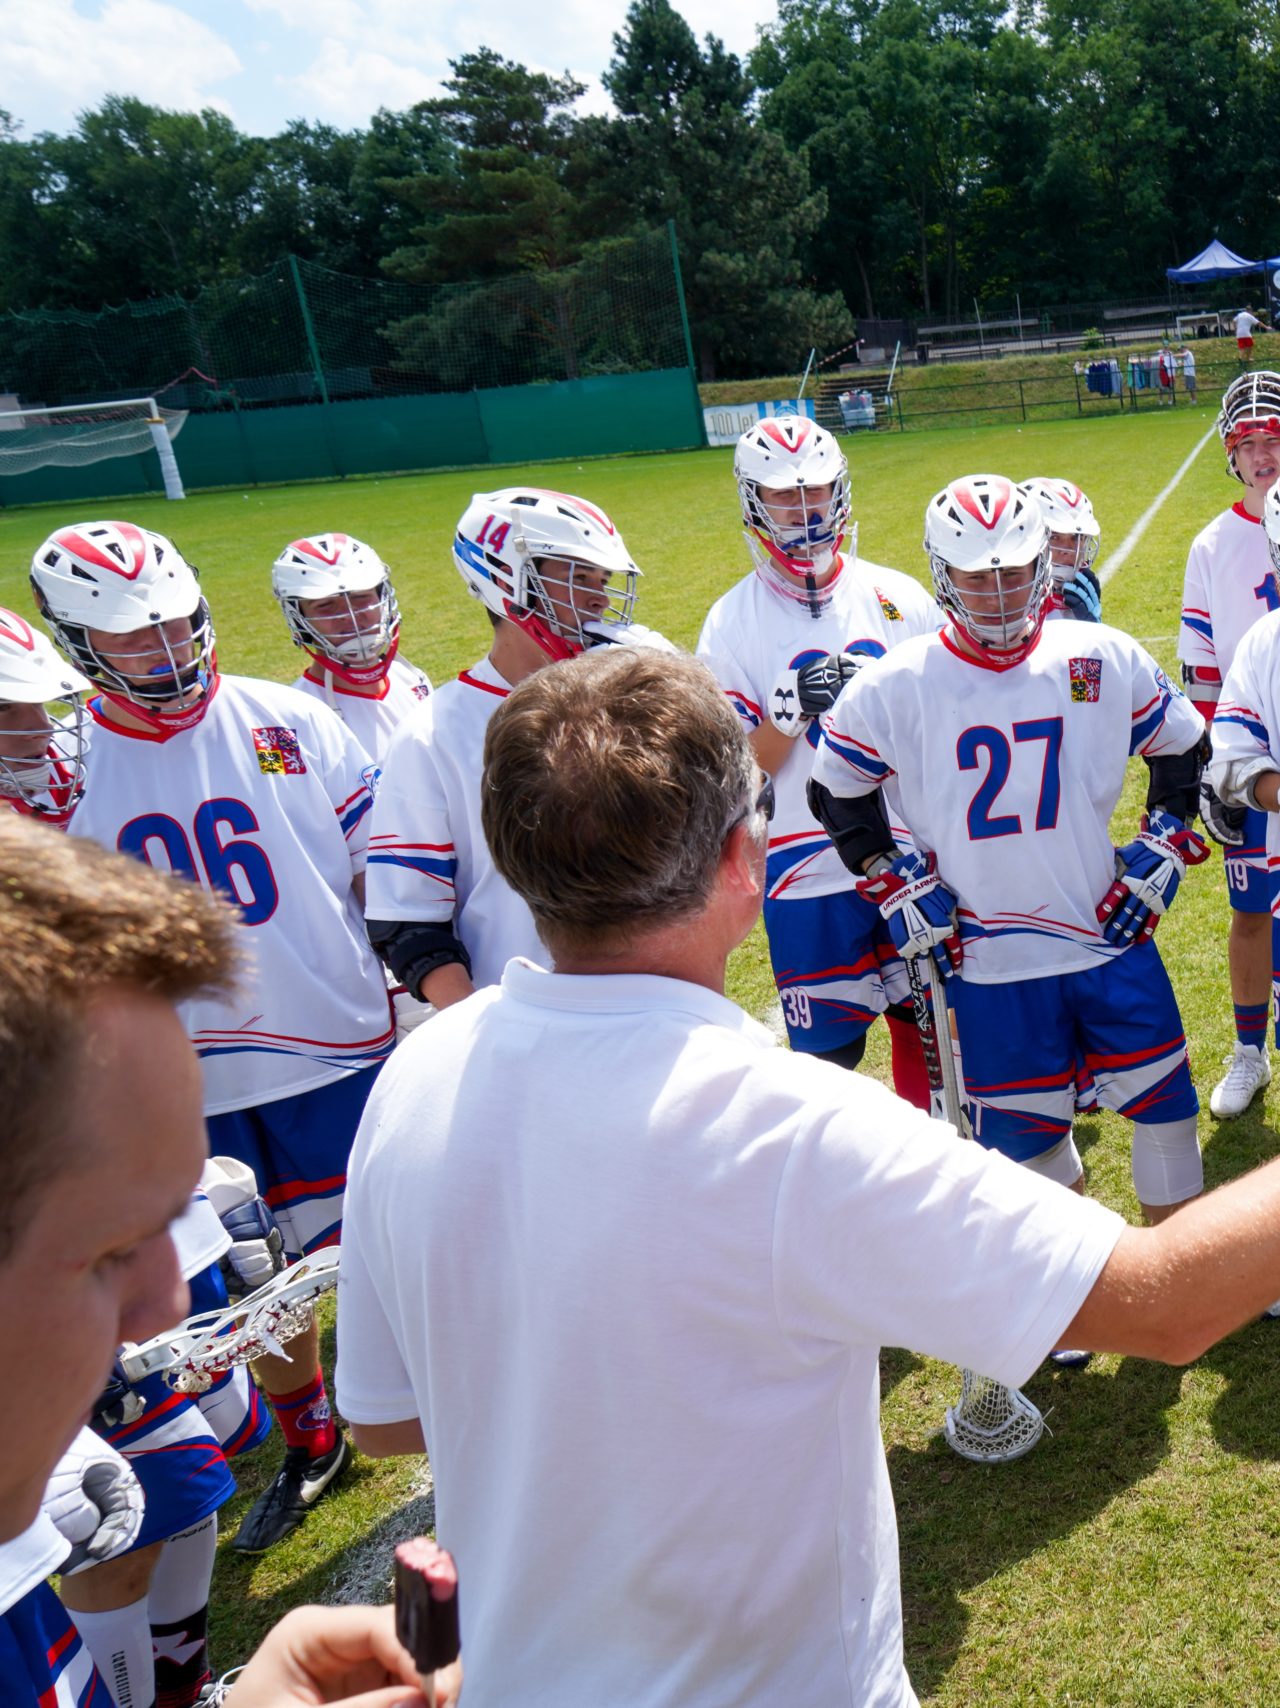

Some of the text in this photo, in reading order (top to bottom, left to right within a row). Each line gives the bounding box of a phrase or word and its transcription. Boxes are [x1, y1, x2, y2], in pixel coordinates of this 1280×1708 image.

[710, 410, 754, 436] 100 let
[474, 513, 512, 554] 14
[956, 715, 1064, 841] 27
[1226, 858, 1249, 894] 19
[882, 886, 912, 912] UNDER
[781, 986, 813, 1030] 39
